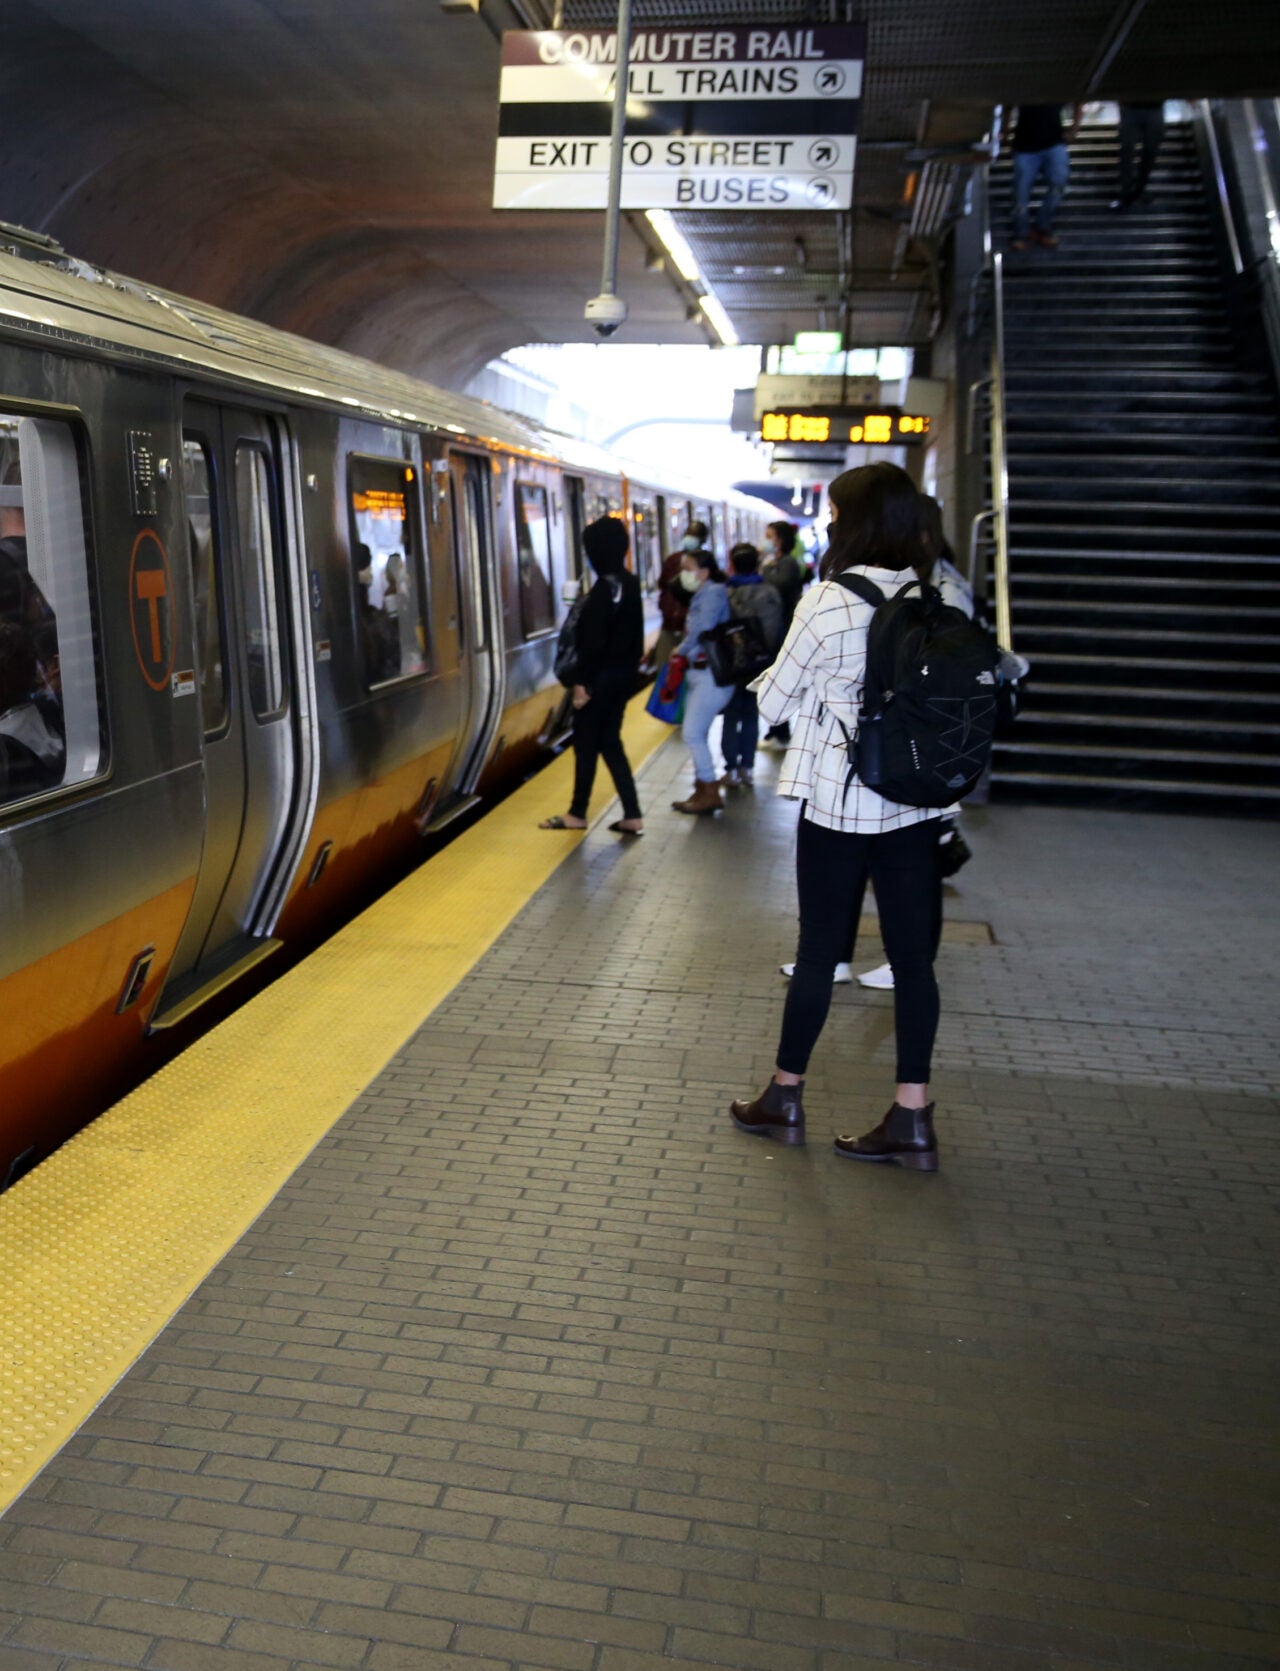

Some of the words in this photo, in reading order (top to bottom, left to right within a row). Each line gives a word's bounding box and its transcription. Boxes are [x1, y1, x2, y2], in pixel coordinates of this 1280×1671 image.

[539, 30, 736, 64] COMMUTER
[747, 29, 825, 60] RAIL
[676, 66, 799, 94] TRAINS
[529, 141, 599, 166] EXIT
[610, 141, 653, 166] O
[666, 141, 794, 166] STREET
[676, 177, 790, 203] BUSES
[136, 569, 166, 664] T
